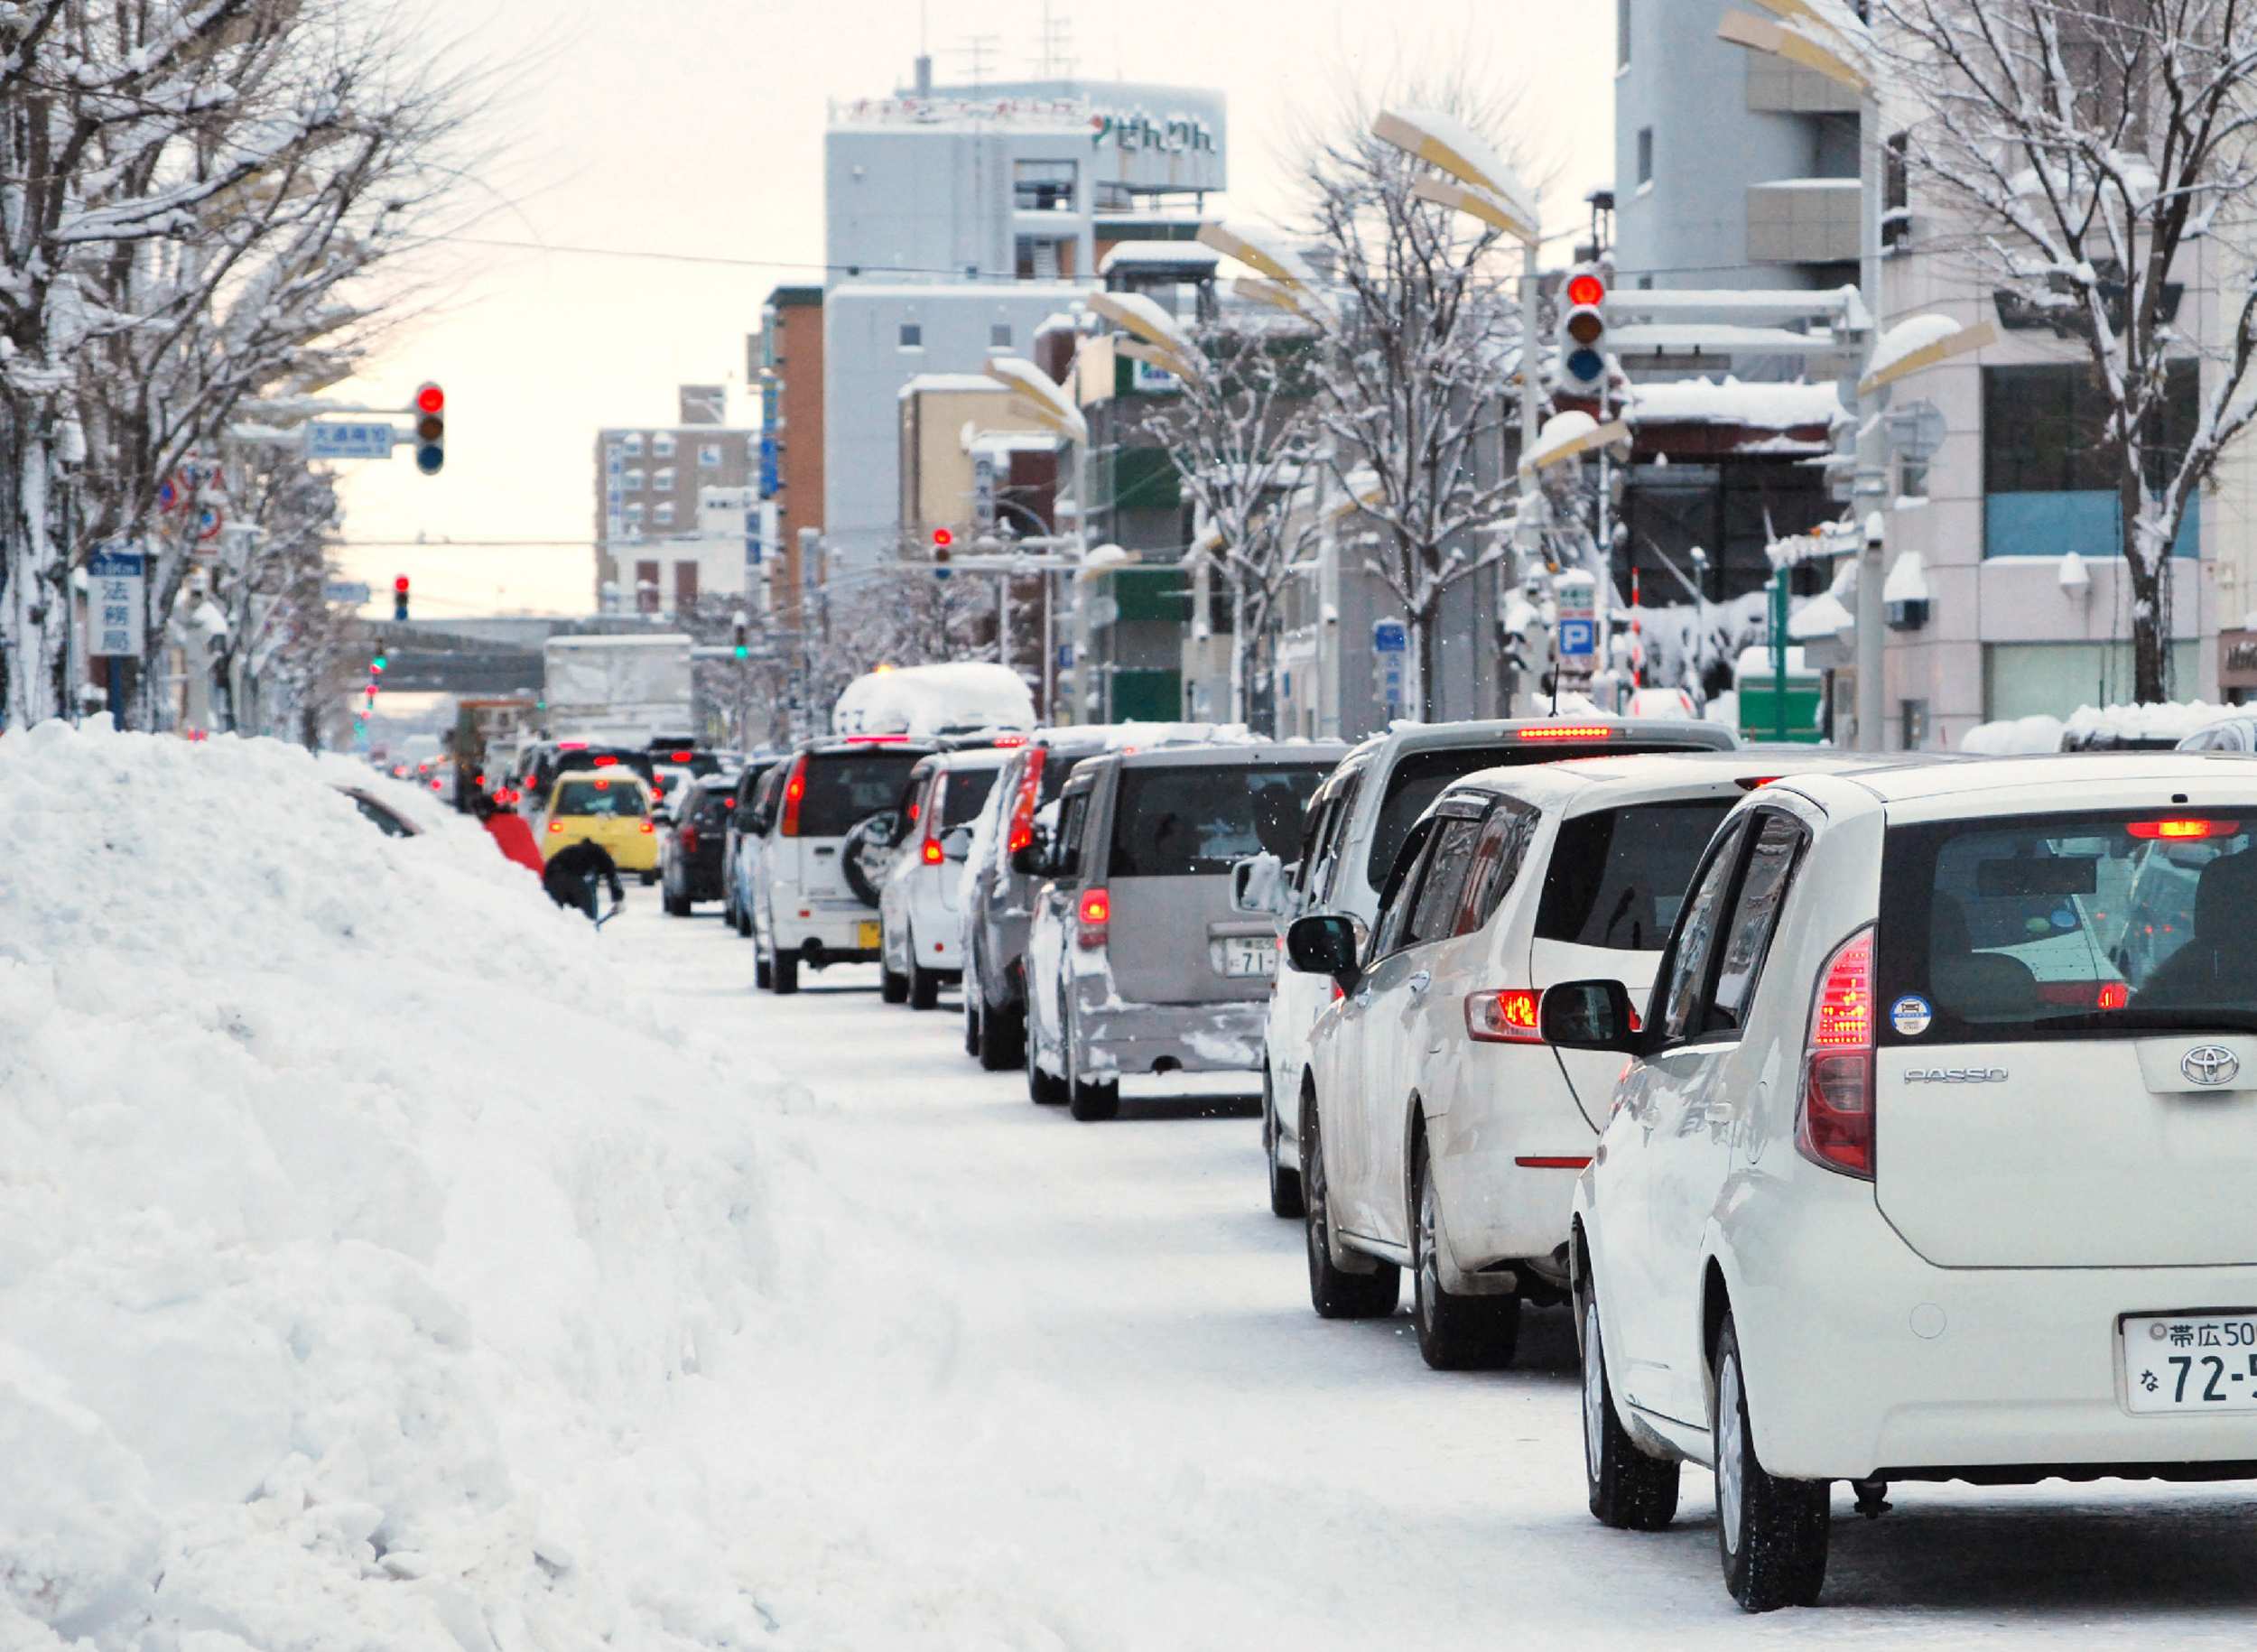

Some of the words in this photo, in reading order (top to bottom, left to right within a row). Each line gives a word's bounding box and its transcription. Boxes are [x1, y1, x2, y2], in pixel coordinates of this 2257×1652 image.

[1564, 624, 1589, 651] P
[1904, 1067, 2009, 1084] PASSO
[2169, 1322, 2257, 1348] 帯広50
[2140, 1369, 2159, 1392] な
